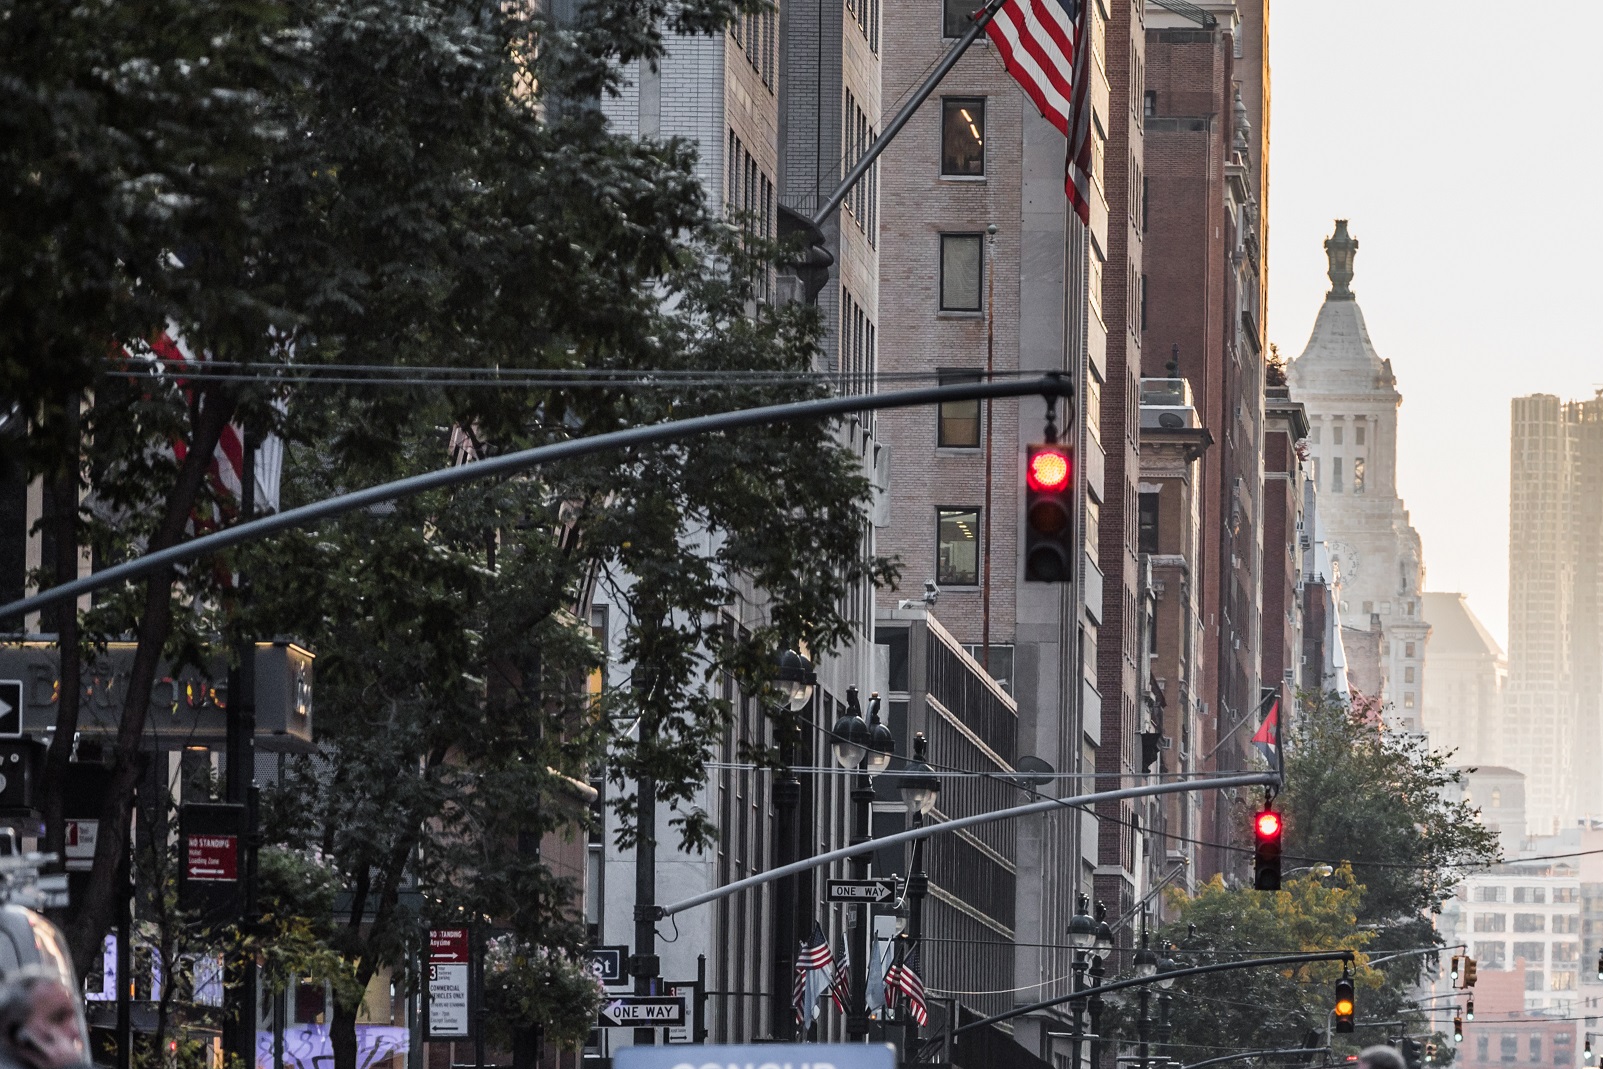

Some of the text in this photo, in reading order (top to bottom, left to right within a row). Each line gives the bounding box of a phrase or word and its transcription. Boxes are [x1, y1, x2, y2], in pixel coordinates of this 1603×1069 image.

[189, 837, 230, 849] NO STANDING
[836, 886, 885, 897] ONE WAY
[430, 930, 463, 939] NO TANDING
[429, 965, 437, 980] 3
[430, 984, 460, 992] COMMERCIAL
[613, 1006, 639, 1018] ONE
[645, 1006, 673, 1018] WAY
